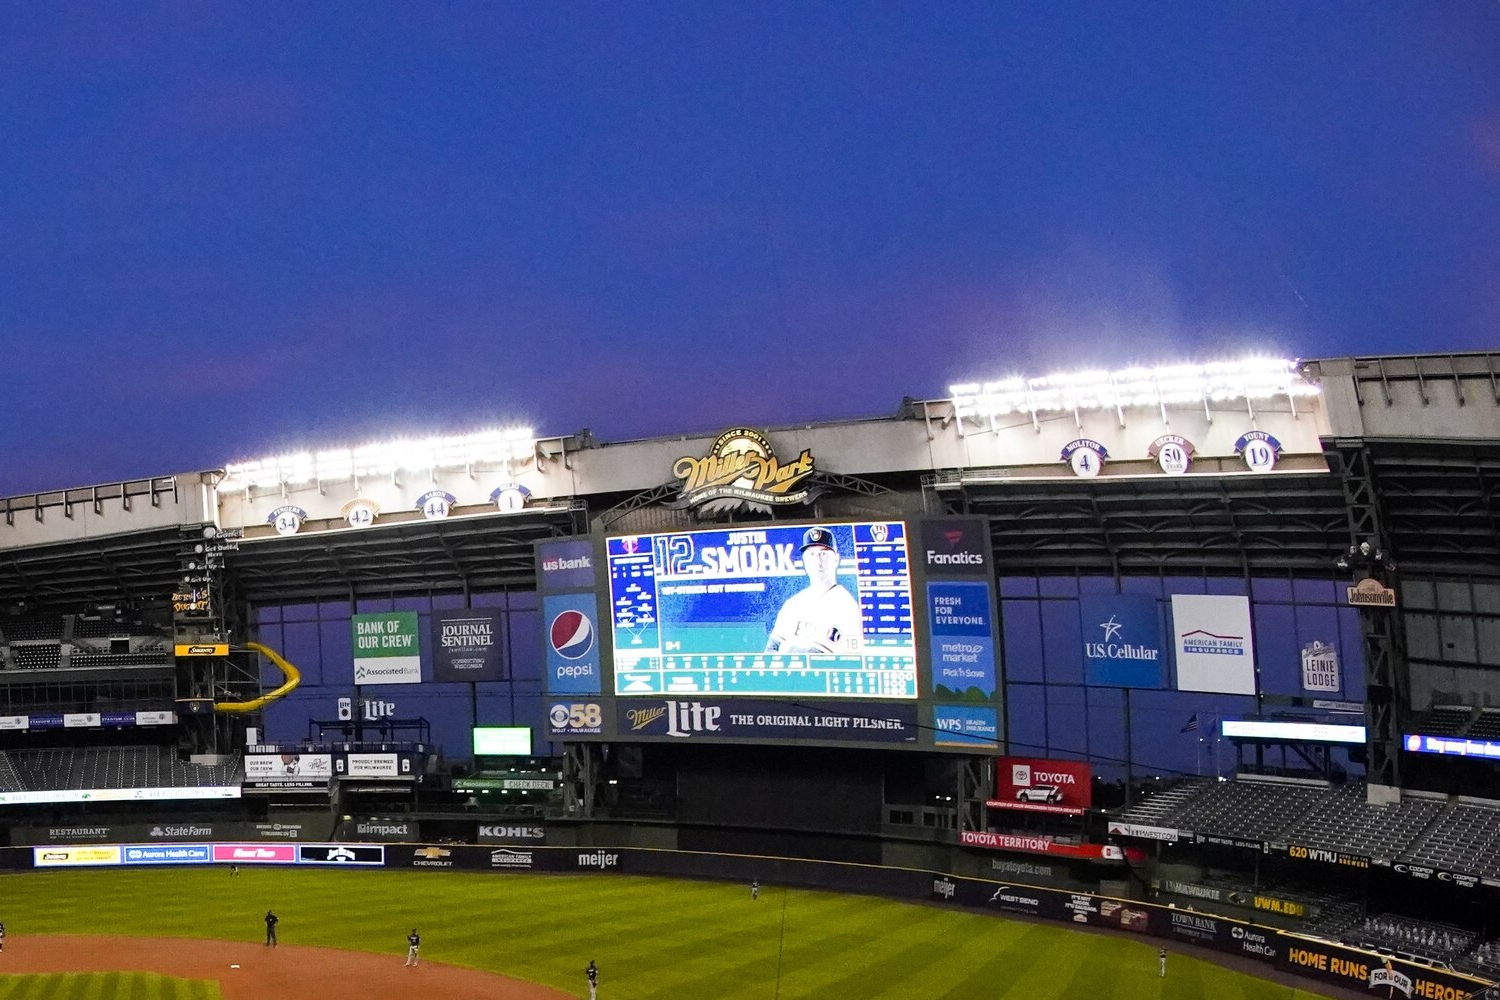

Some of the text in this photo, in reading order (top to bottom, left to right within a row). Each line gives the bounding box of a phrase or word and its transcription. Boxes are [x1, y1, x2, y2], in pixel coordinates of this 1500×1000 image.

[719, 430, 762, 445] SINCE 2001
[1243, 432, 1270, 442] YOUNT
[1067, 441, 1100, 452] MOLITOR
[1079, 454, 1091, 471] 4
[1164, 448, 1181, 463] 50
[1250, 447, 1270, 467] 19
[673, 449, 760, 494] Miller
[424, 491, 446, 499] AARON
[690, 491, 709, 504] HOME
[734, 488, 774, 502] MILWAUKEE
[775, 491, 808, 502] BREWERS
[274, 507, 300, 517] FINGERS
[352, 509, 370, 523] 42
[427, 502, 444, 516] 44
[279, 517, 296, 531] 34
[656, 531, 767, 576] 12 JUSTIN
[702, 543, 794, 574] SMOAK
[927, 550, 983, 564] Fanatics
[934, 597, 962, 605] FRESH
[1350, 589, 1394, 604] Johnsonville
[935, 606, 953, 615] FOR
[357, 620, 400, 634] BANK OF
[441, 624, 494, 637] JOURNAL
[358, 635, 412, 649] OUR CREW
[441, 636, 494, 647] SENTINEL
[942, 643, 973, 653] metro
[1184, 639, 1243, 648] AMERICAN FAMILY
[943, 653, 978, 662] market
[557, 664, 593, 679] pepsi
[1306, 659, 1335, 673] LEINIE
[966, 669, 985, 678] Save
[1306, 673, 1336, 687] LODGE
[364, 700, 395, 721] Lite
[569, 703, 602, 728] 58
[627, 701, 905, 738] Miller Lite THE ORIGINAL LIGHT PILSNER.
[937, 718, 962, 731] WPS
[509, 780, 531, 788] CHECK
[1033, 771, 1075, 784] TOYOTA
[49, 827, 107, 835] RESTAURANT
[366, 822, 408, 835] impact
[479, 826, 545, 838] KOHL'S
[961, 832, 1051, 850] TOYOTA TERRITORY
[166, 850, 188, 858] Health
[189, 850, 205, 858] Care
[578, 851, 619, 869] meijer
[1289, 846, 1338, 864] 620 WTMJ
[992, 859, 1052, 876] buyatoyota.com
[1339, 858, 1369, 869] BREWERS
[1409, 865, 1434, 875] COOPER
[1452, 873, 1478, 882] COOPER
[1000, 894, 1039, 906] WEST BEND
[1171, 913, 1217, 930] TOWN BANK
[1243, 931, 1265, 943] Aurora
[1243, 941, 1264, 955] Health
[1288, 947, 1368, 981] HOME RUNS
[1374, 971, 1408, 988] FOR OUR
